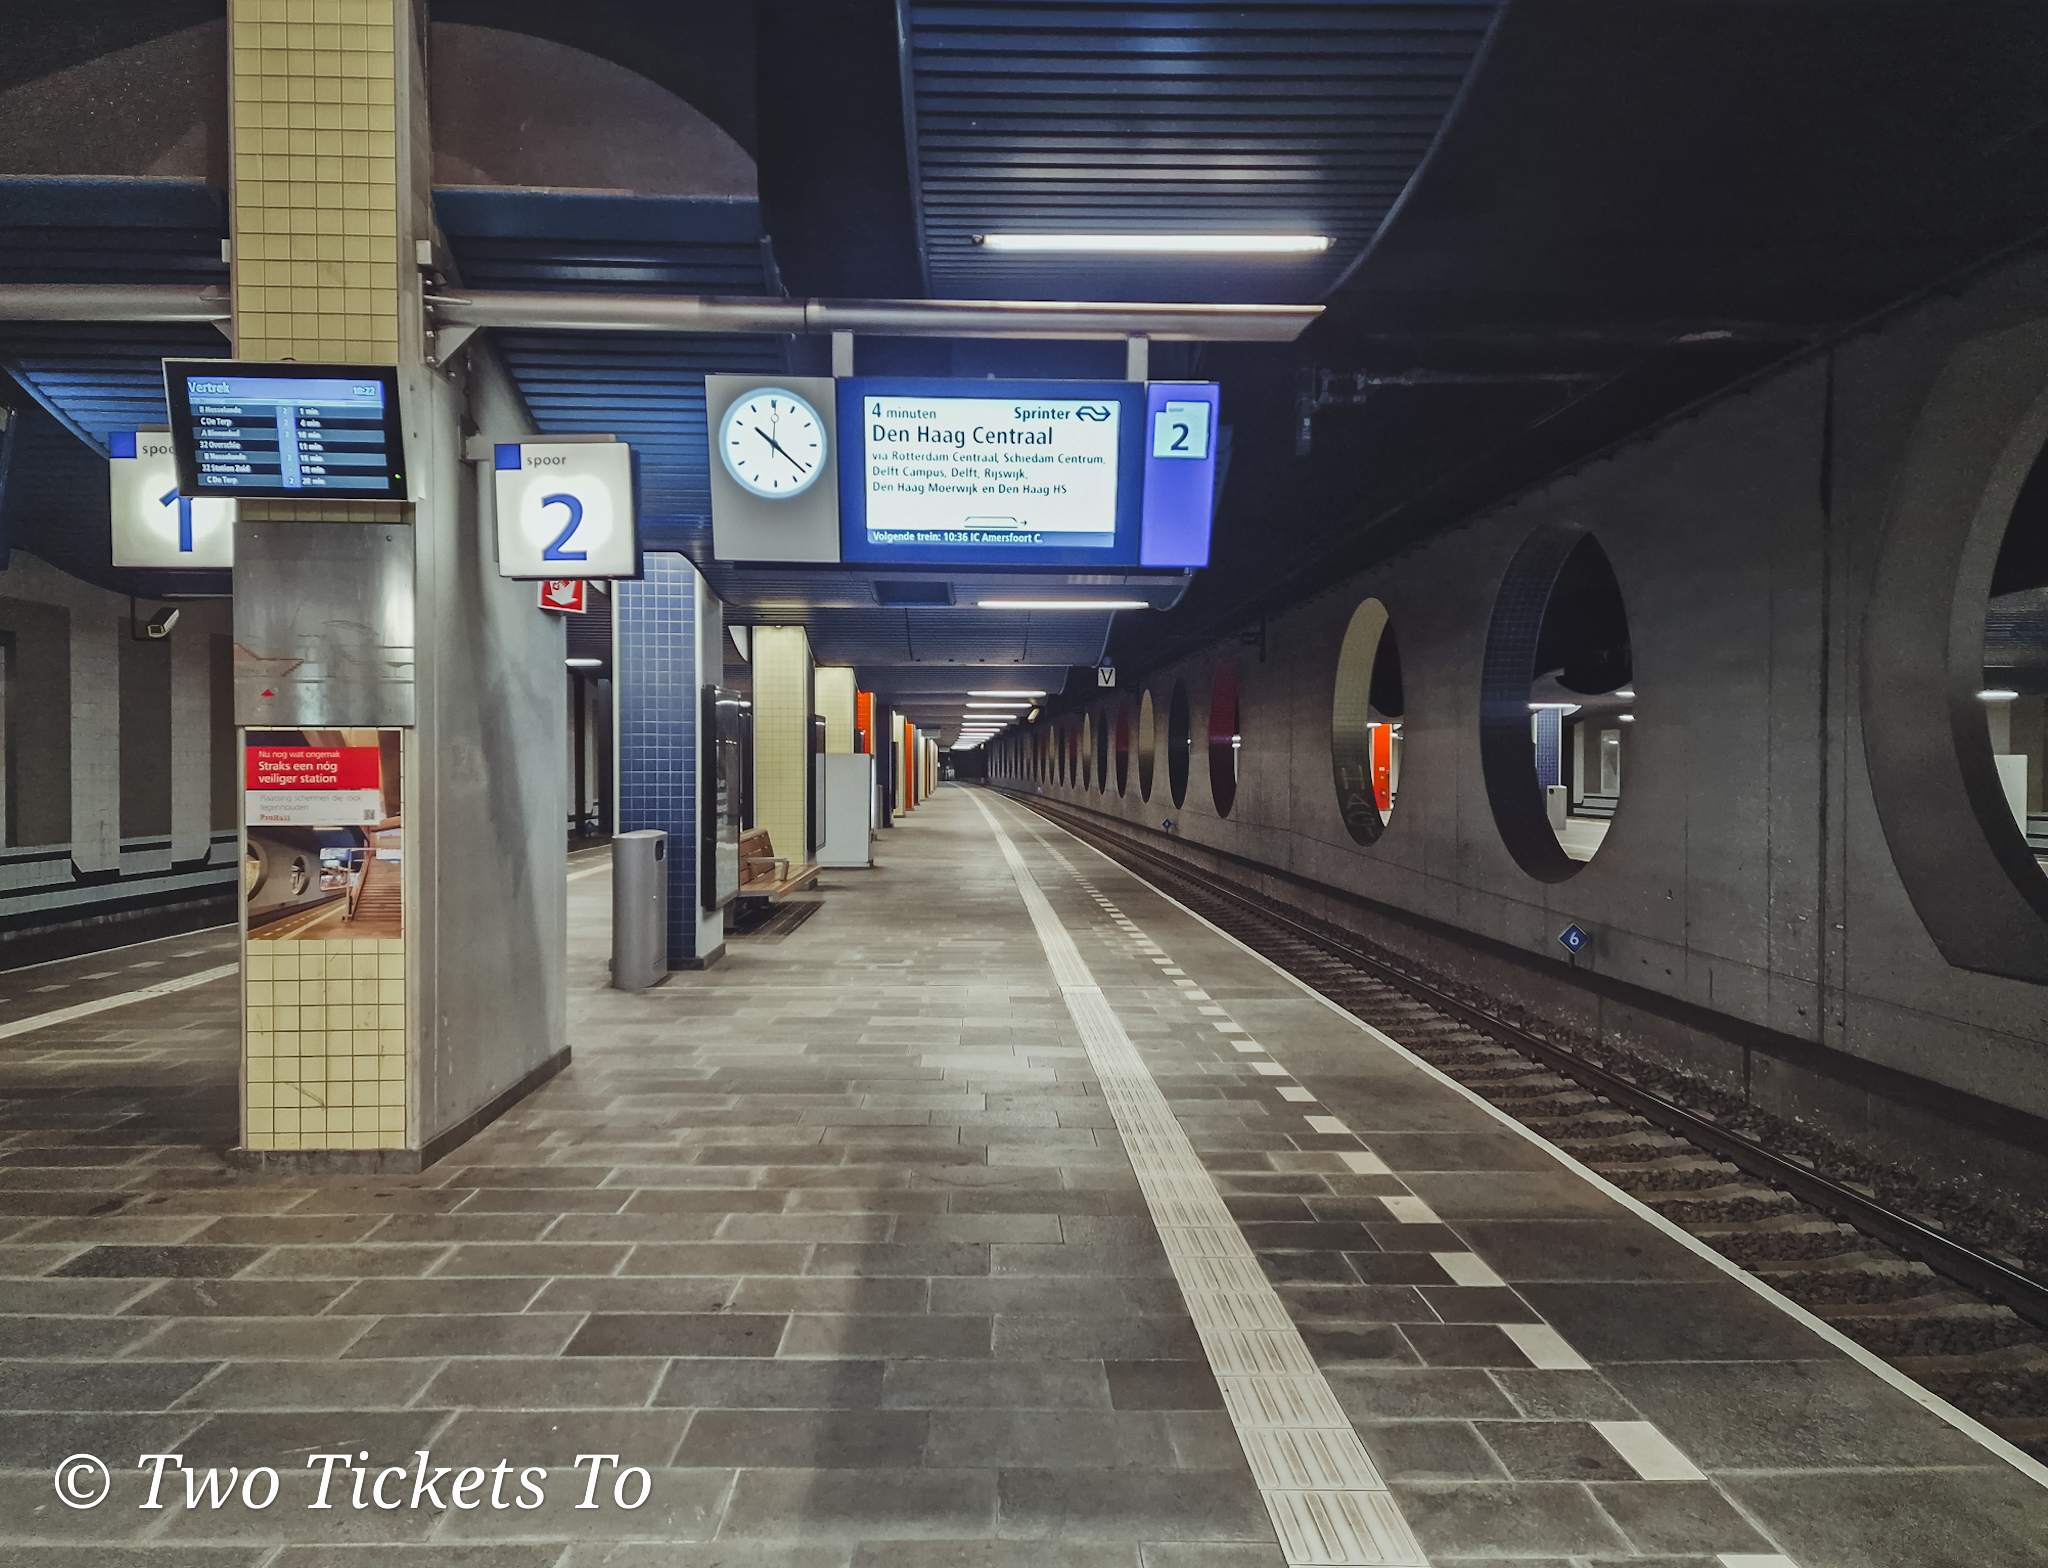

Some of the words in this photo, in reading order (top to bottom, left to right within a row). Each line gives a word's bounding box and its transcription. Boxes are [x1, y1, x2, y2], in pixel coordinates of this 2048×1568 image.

[187, 382, 230, 394] Vertrek
[872, 402, 881, 418] 4
[886, 407, 937, 419] minuten
[1014, 406, 1071, 422] Sprinter
[873, 424, 909, 442] Den
[918, 425, 965, 449] Haag
[973, 426, 1053, 445] Centraal
[1170, 423, 1189, 451] 2
[200, 441, 208, 449] 32
[527, 456, 567, 469] spoor
[872, 452, 888, 461] via
[892, 451, 949, 461] Rotterdam
[952, 452, 999, 464] Centraal,
[1004, 453, 1054, 463] Schiedam
[872, 466, 899, 476] Delft
[902, 467, 947, 479] Campus,
[951, 467, 980, 479] Delft,
[872, 482, 894, 492] Den
[897, 483, 924, 495] Haag
[928, 483, 978, 496] Moerwijk
[982, 486, 995, 494] en
[998, 484, 1019, 494] Den
[1023, 485, 1050, 497] Haag
[1053, 485, 1067, 494] HS
[159, 487, 192, 552] 1
[541, 493, 588, 561] 2
[873, 532, 916, 542] Volgende
[916, 532, 941, 542] trein:
[943, 532, 969, 542] 10:36
[970, 533, 981, 542] IC
[981, 533, 1033, 543] Amersfoort
[1034, 534, 1043, 543] C.
[1101, 669, 1113, 685] V
[258, 751, 271, 759] Nu
[272, 752, 288, 760] nog
[289, 751, 304, 759] wat
[305, 751, 340, 760] ongemak
[258, 761, 291, 772] Straks
[293, 764, 313, 772] een
[316, 761, 338, 773] nóg
[258, 773, 297, 785] veiliger
[300, 773, 337, 784] station
[1569, 931, 1580, 946] 6
